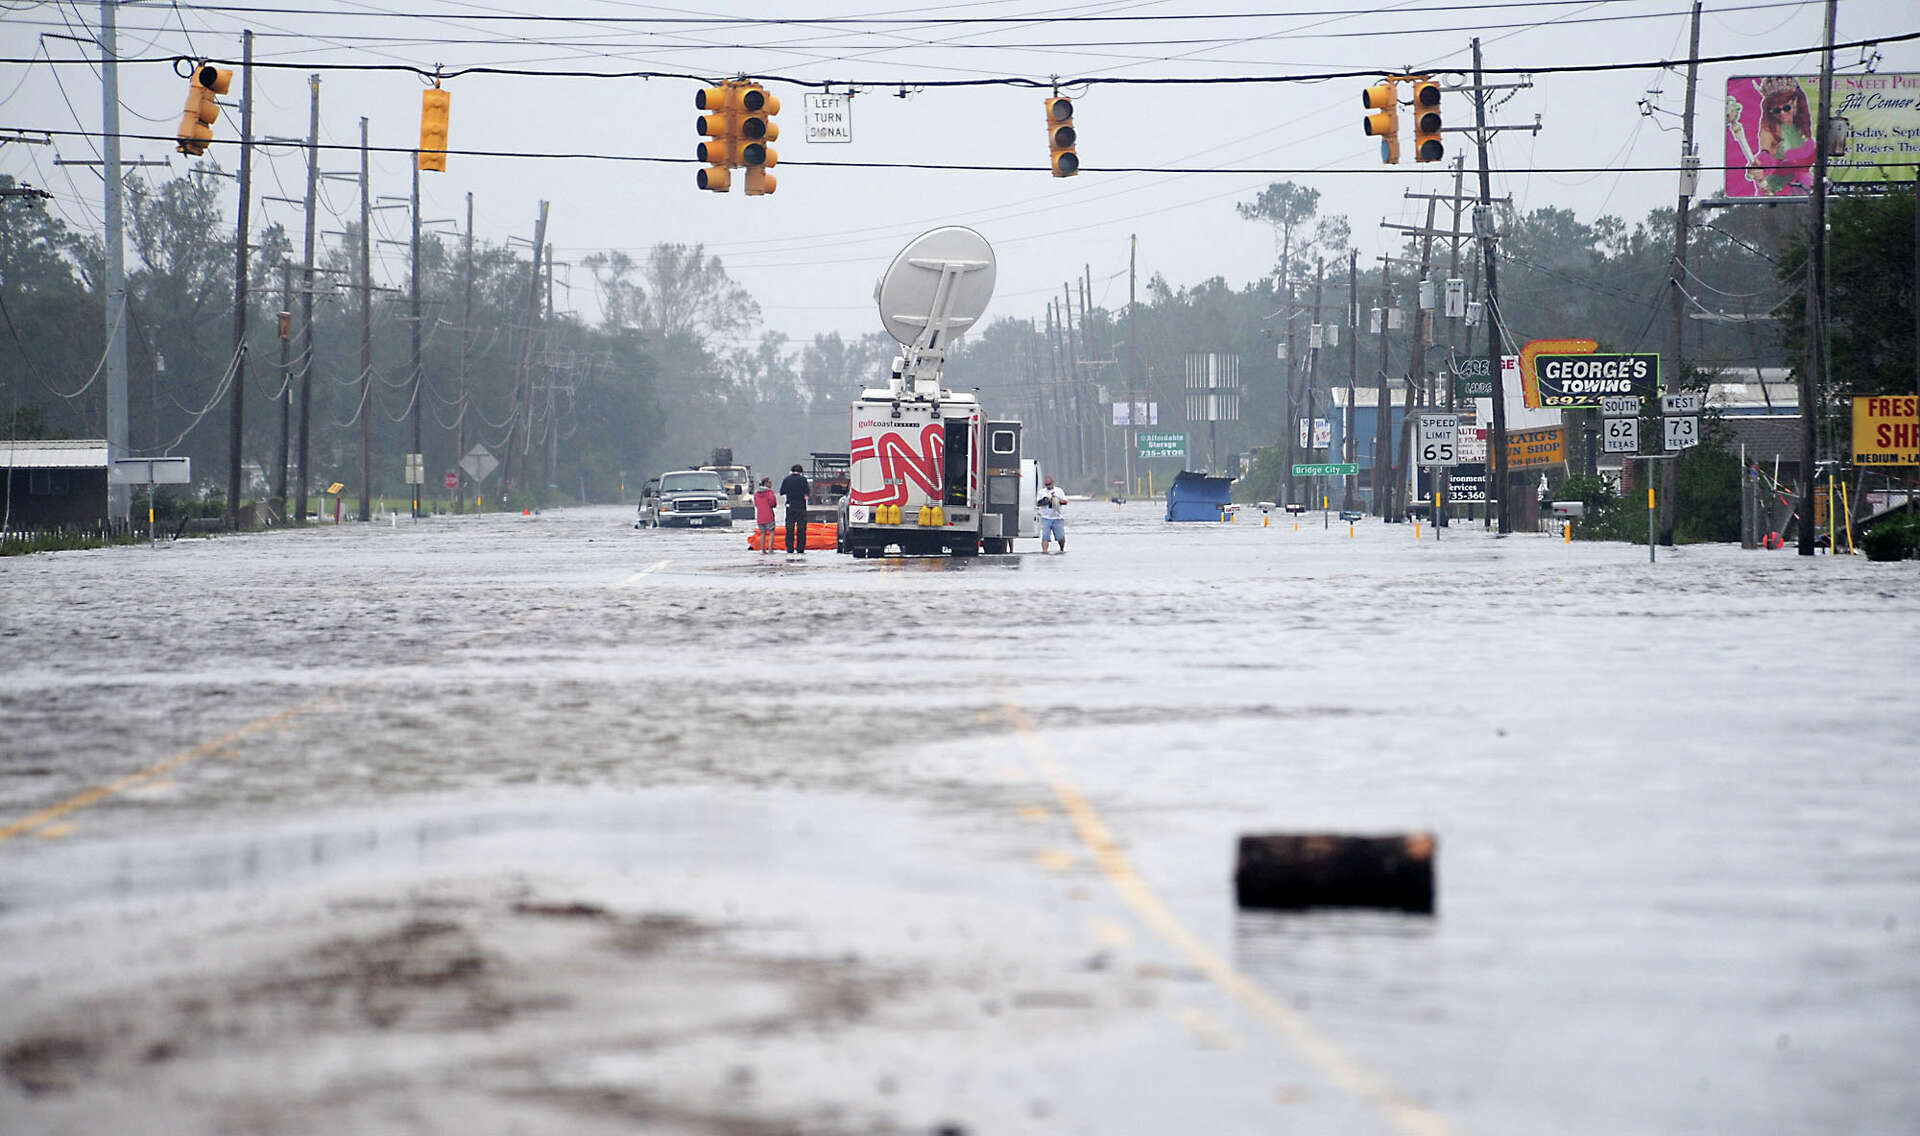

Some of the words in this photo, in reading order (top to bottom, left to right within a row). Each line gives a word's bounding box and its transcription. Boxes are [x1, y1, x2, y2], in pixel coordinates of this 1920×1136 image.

[815, 98, 840, 109] LEFT
[1839, 92, 1866, 113] Jill
[814, 112, 842, 122] TURN
[1892, 126, 1920, 139] Sept
[1856, 143, 1895, 154] Rogers
[1545, 358, 1648, 379] GEORGE'S
[1561, 379, 1632, 393] TOWING
[1605, 401, 1637, 412] SOUTH
[1667, 397, 1694, 409] WEST
[1422, 419, 1456, 428] SPEED
[1670, 420, 1692, 435] 73
[1610, 422, 1633, 437] 62
[1146, 433, 1184, 441] Affordable
[1425, 431, 1452, 440] LIMIT
[1148, 441, 1177, 449] Storage
[1527, 442, 1560, 454] SHOP
[1608, 440, 1635, 449] TEXAS
[1668, 438, 1696, 447] TEXAS
[1423, 444, 1453, 461] 65
[1856, 453, 1899, 464] MEDIUM
[1296, 466, 1322, 476] Bridge
[1325, 466, 1341, 475] City
[1350, 465, 1356, 473] 2
[1448, 483, 1478, 491] ervices
